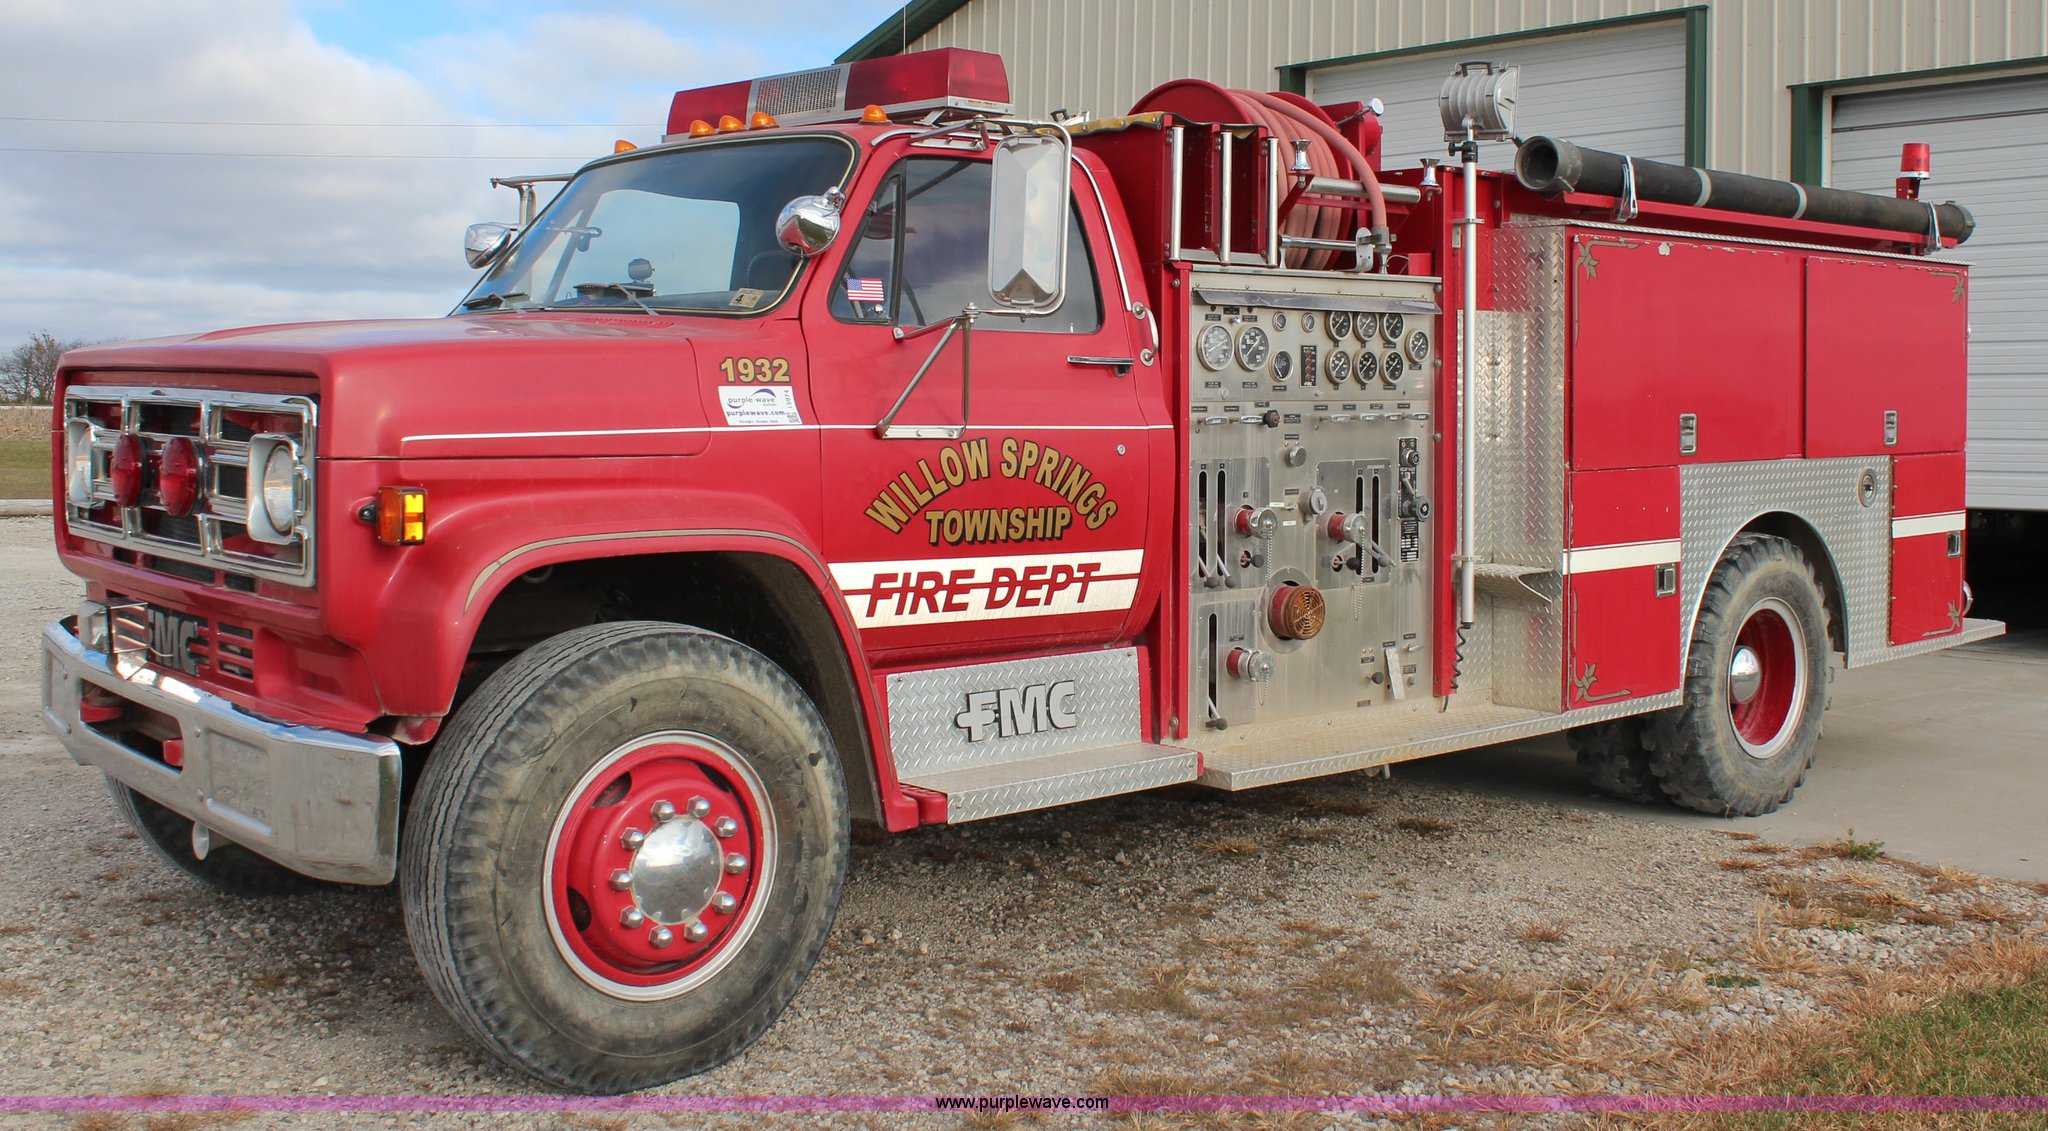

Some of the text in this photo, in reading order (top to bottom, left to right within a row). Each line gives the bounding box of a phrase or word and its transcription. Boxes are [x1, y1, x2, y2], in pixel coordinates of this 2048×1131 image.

[720, 357, 791, 383] 1932
[864, 437, 1118, 534] WILLOW SPRINGS
[925, 506, 1072, 544] TOWNSHIP
[866, 562, 1101, 617] FIRE DEPT
[954, 680, 1077, 742] FMC
